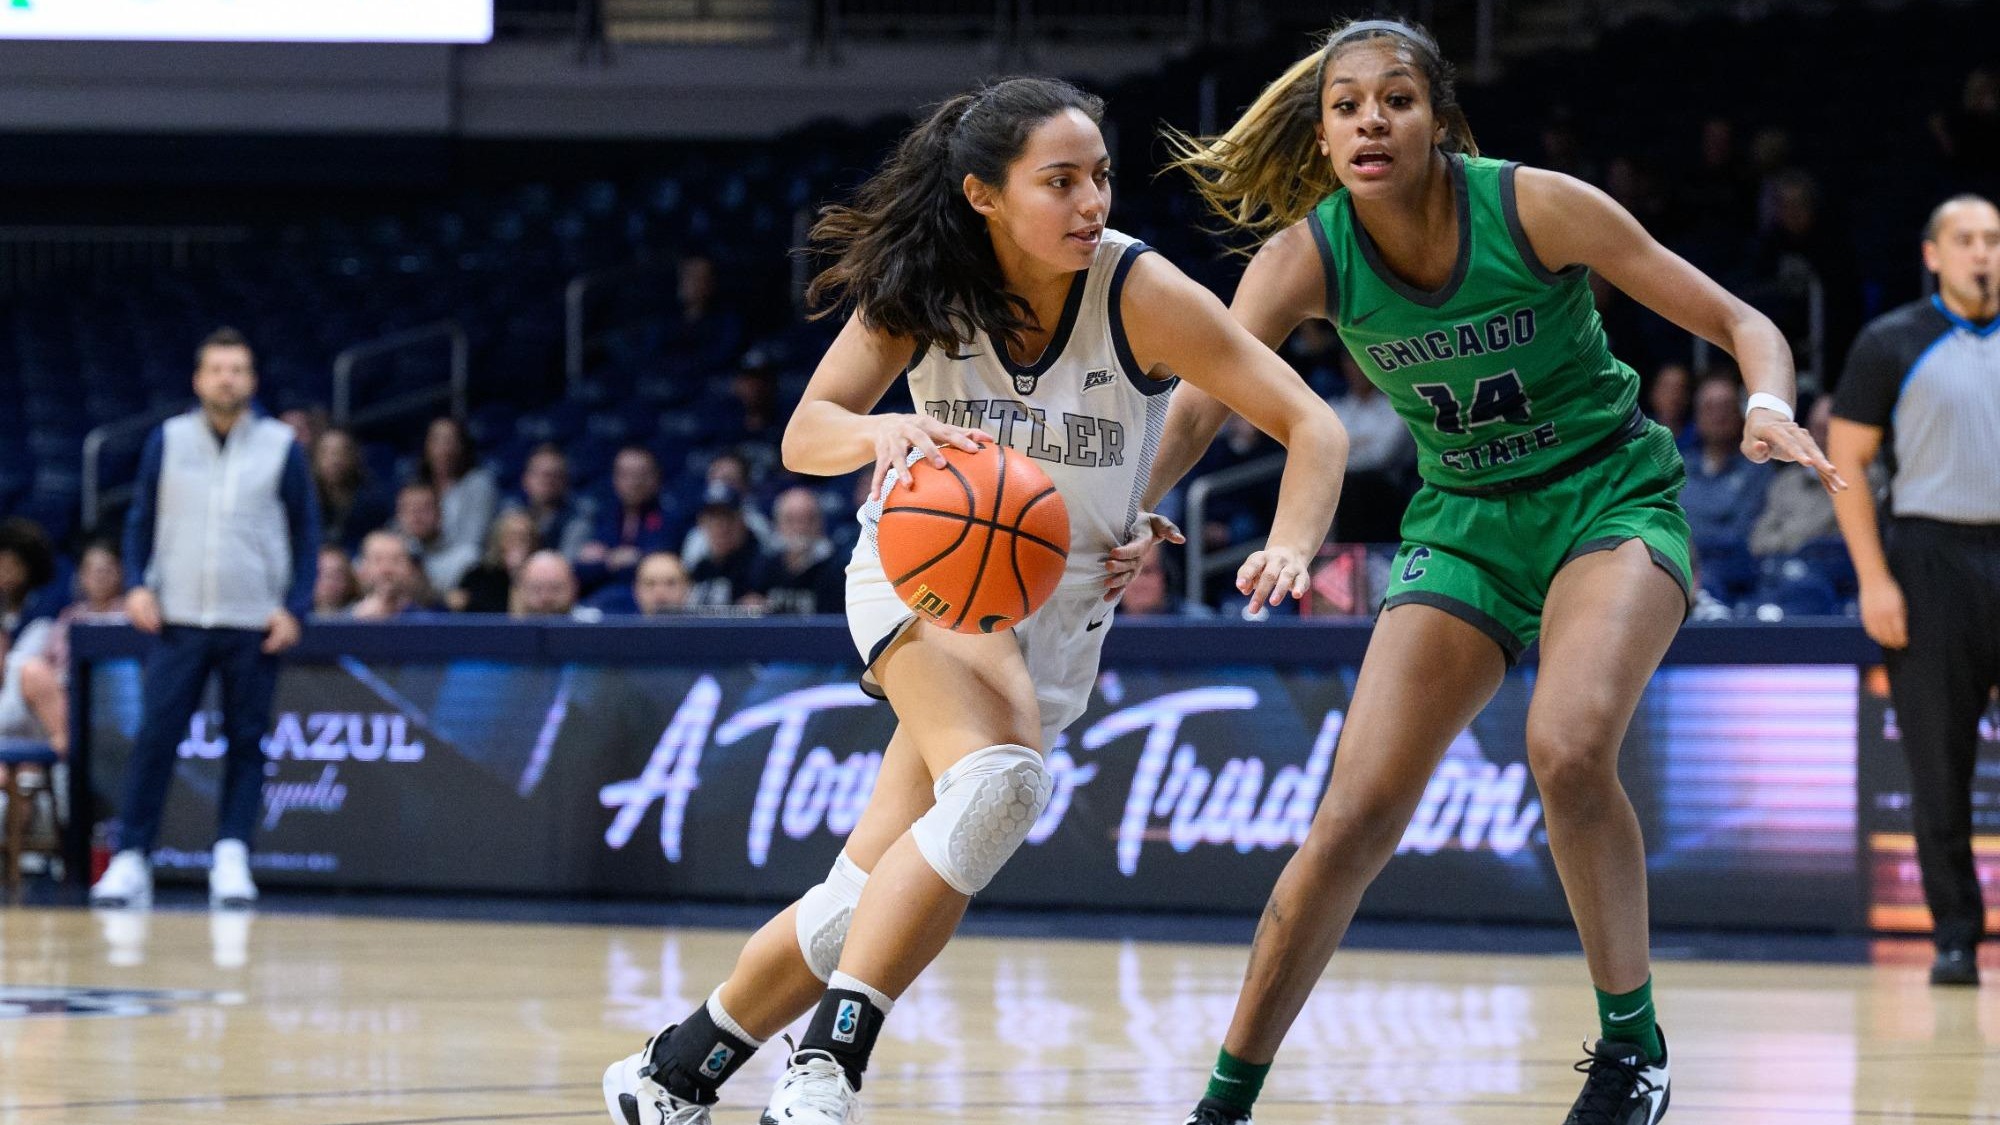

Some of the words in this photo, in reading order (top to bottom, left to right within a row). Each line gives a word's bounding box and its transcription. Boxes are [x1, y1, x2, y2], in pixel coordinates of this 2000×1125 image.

[1365, 307, 1537, 372] CHICAGO
[1084, 374, 1115, 387] EAST
[1086, 370, 1108, 380] BIG
[1411, 368, 1533, 435] 14
[1440, 421, 1562, 472] STATE
[1400, 547, 1432, 583] C
[259, 711, 426, 763] AZUL
[599, 674, 722, 864] A
